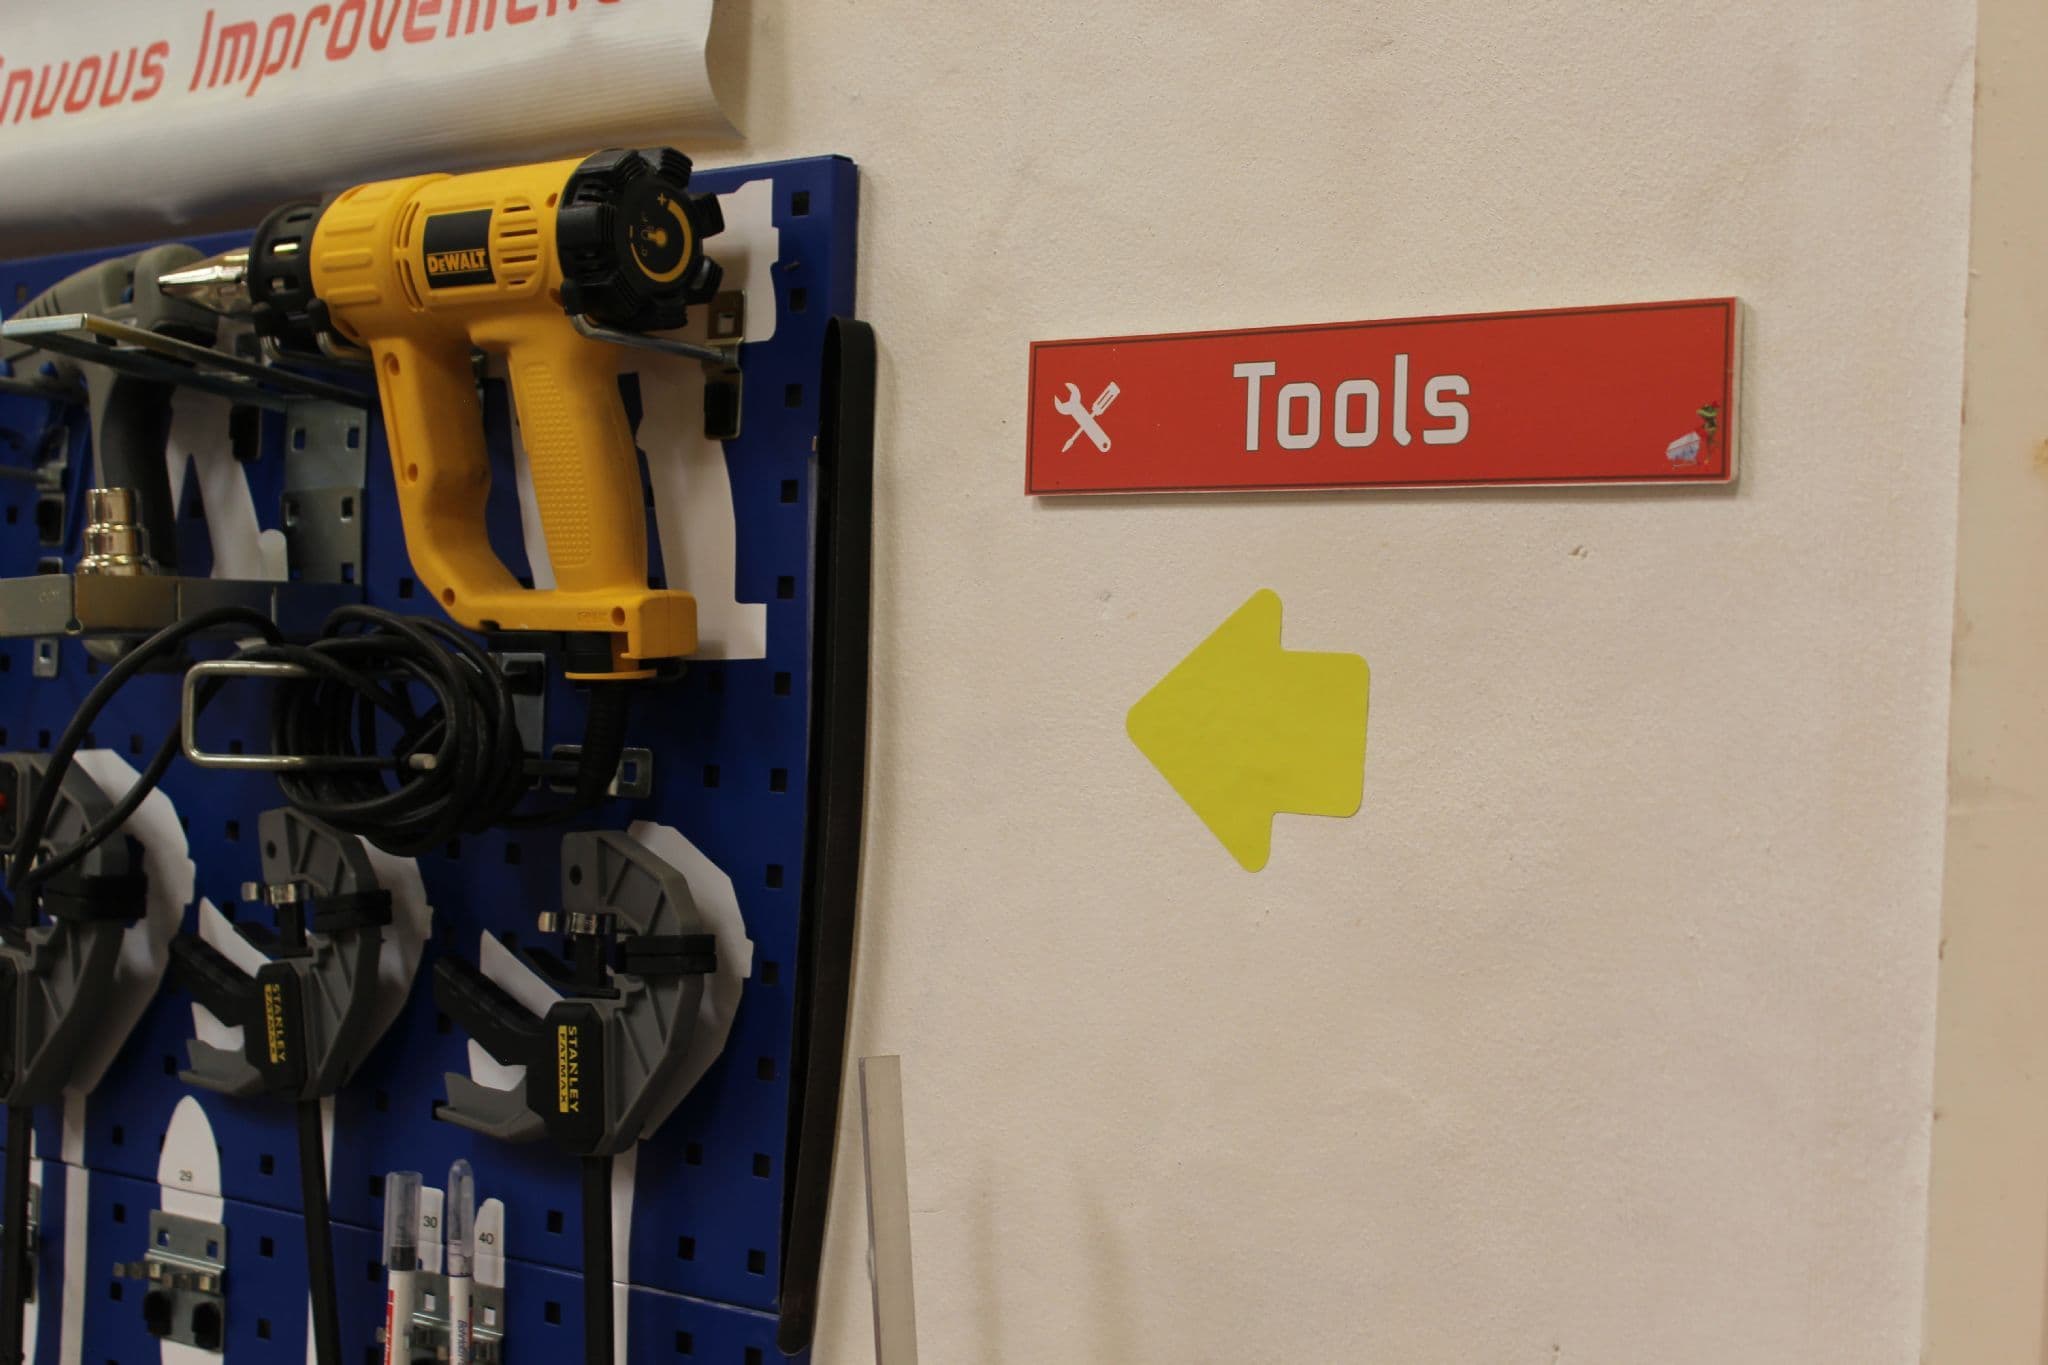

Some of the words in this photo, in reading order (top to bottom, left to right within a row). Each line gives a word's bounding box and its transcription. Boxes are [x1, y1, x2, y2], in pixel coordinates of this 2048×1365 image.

[0, 39, 170, 126] nuous
[188, 0, 622, 98] Improvem
[1233, 353, 1471, 451] Tools
[272, 983, 287, 1062] STANLEY
[559, 1032, 568, 1104] FATMAX
[568, 1025, 579, 1113] STANLEY
[179, 1169, 193, 1182] 29
[423, 1215, 438, 1229] 30
[479, 1232, 494, 1245] 40
